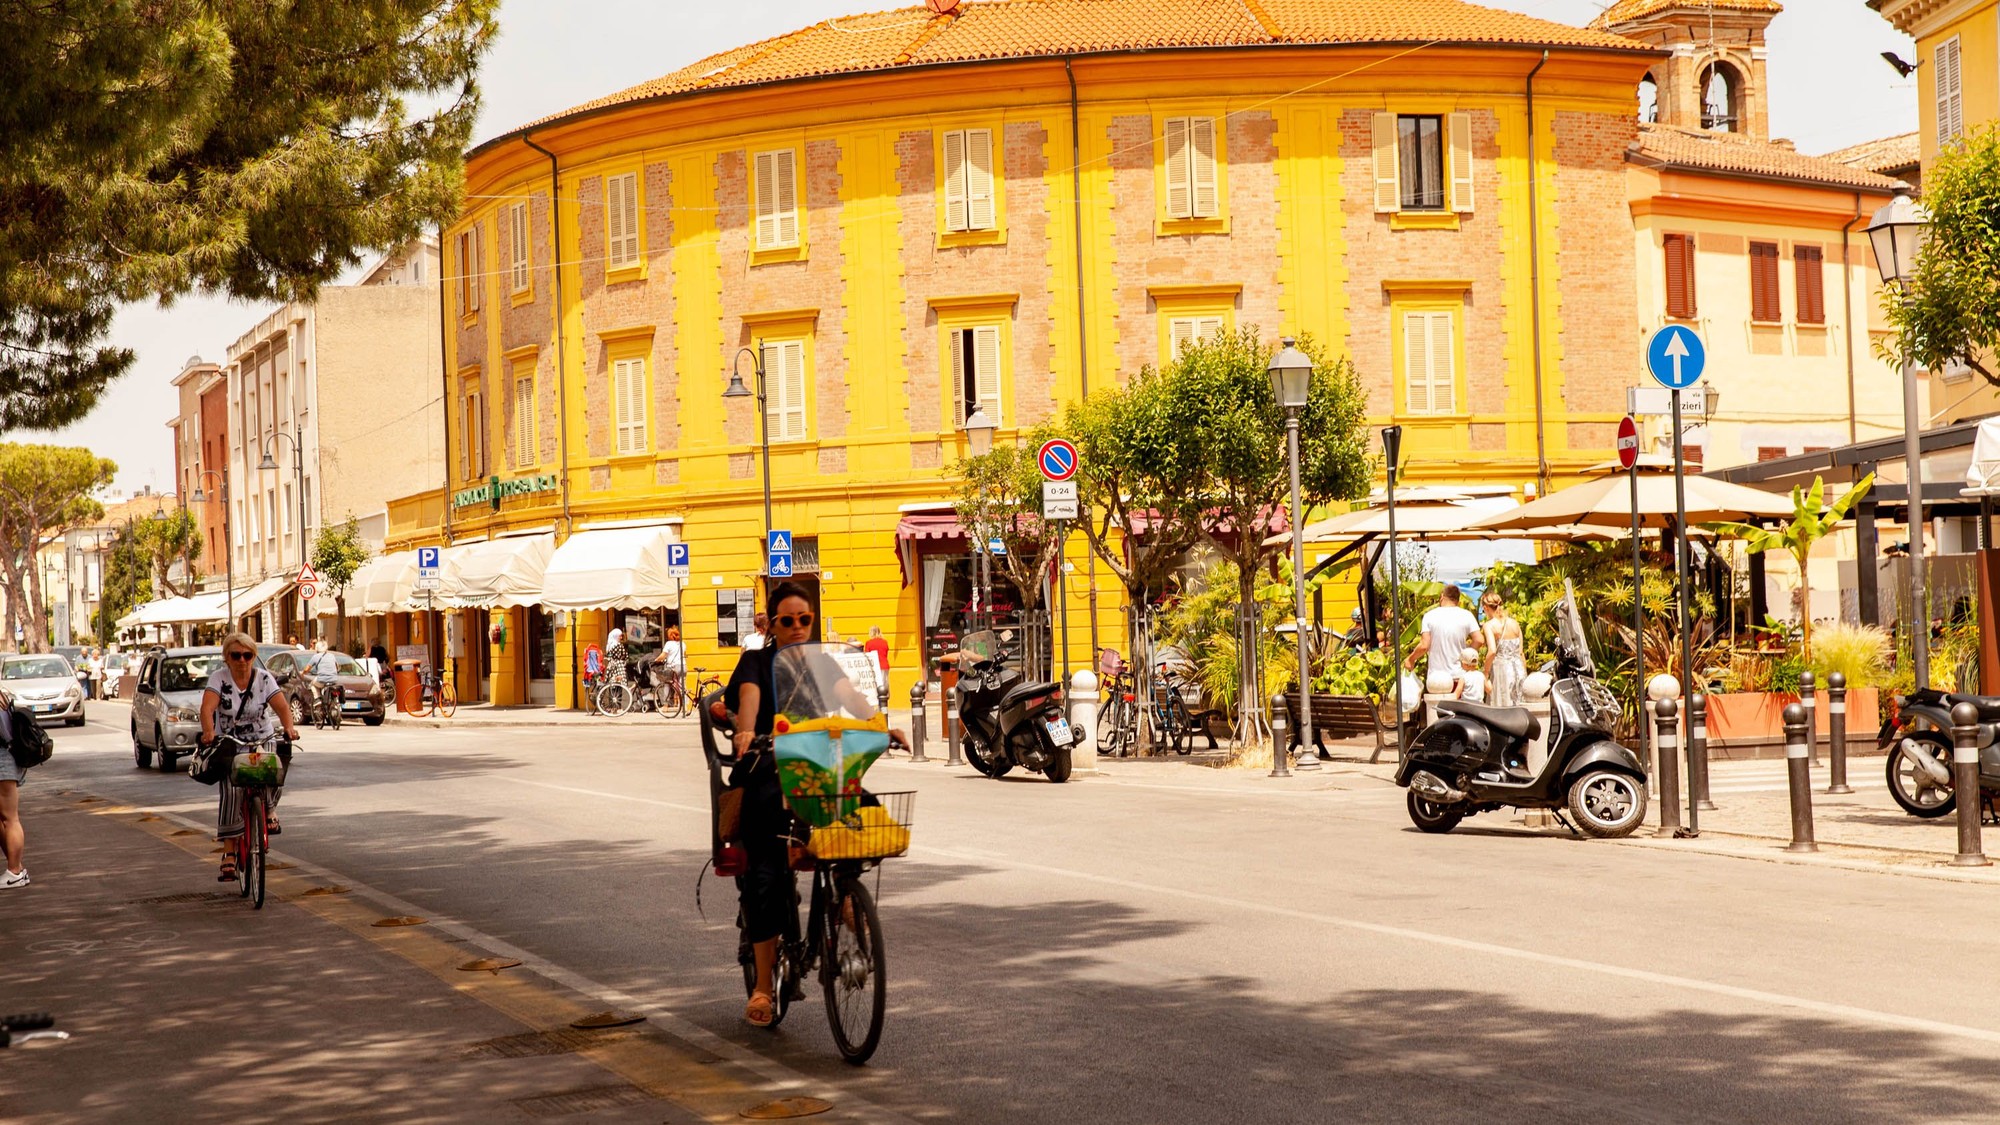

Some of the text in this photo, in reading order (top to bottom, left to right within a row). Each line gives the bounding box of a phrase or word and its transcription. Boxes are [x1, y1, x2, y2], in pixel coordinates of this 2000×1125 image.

[1668, 401, 1701, 410] fzieri
[422, 549, 435, 567] P
[671, 545, 685, 565] P
[302, 587, 313, 595] 30
